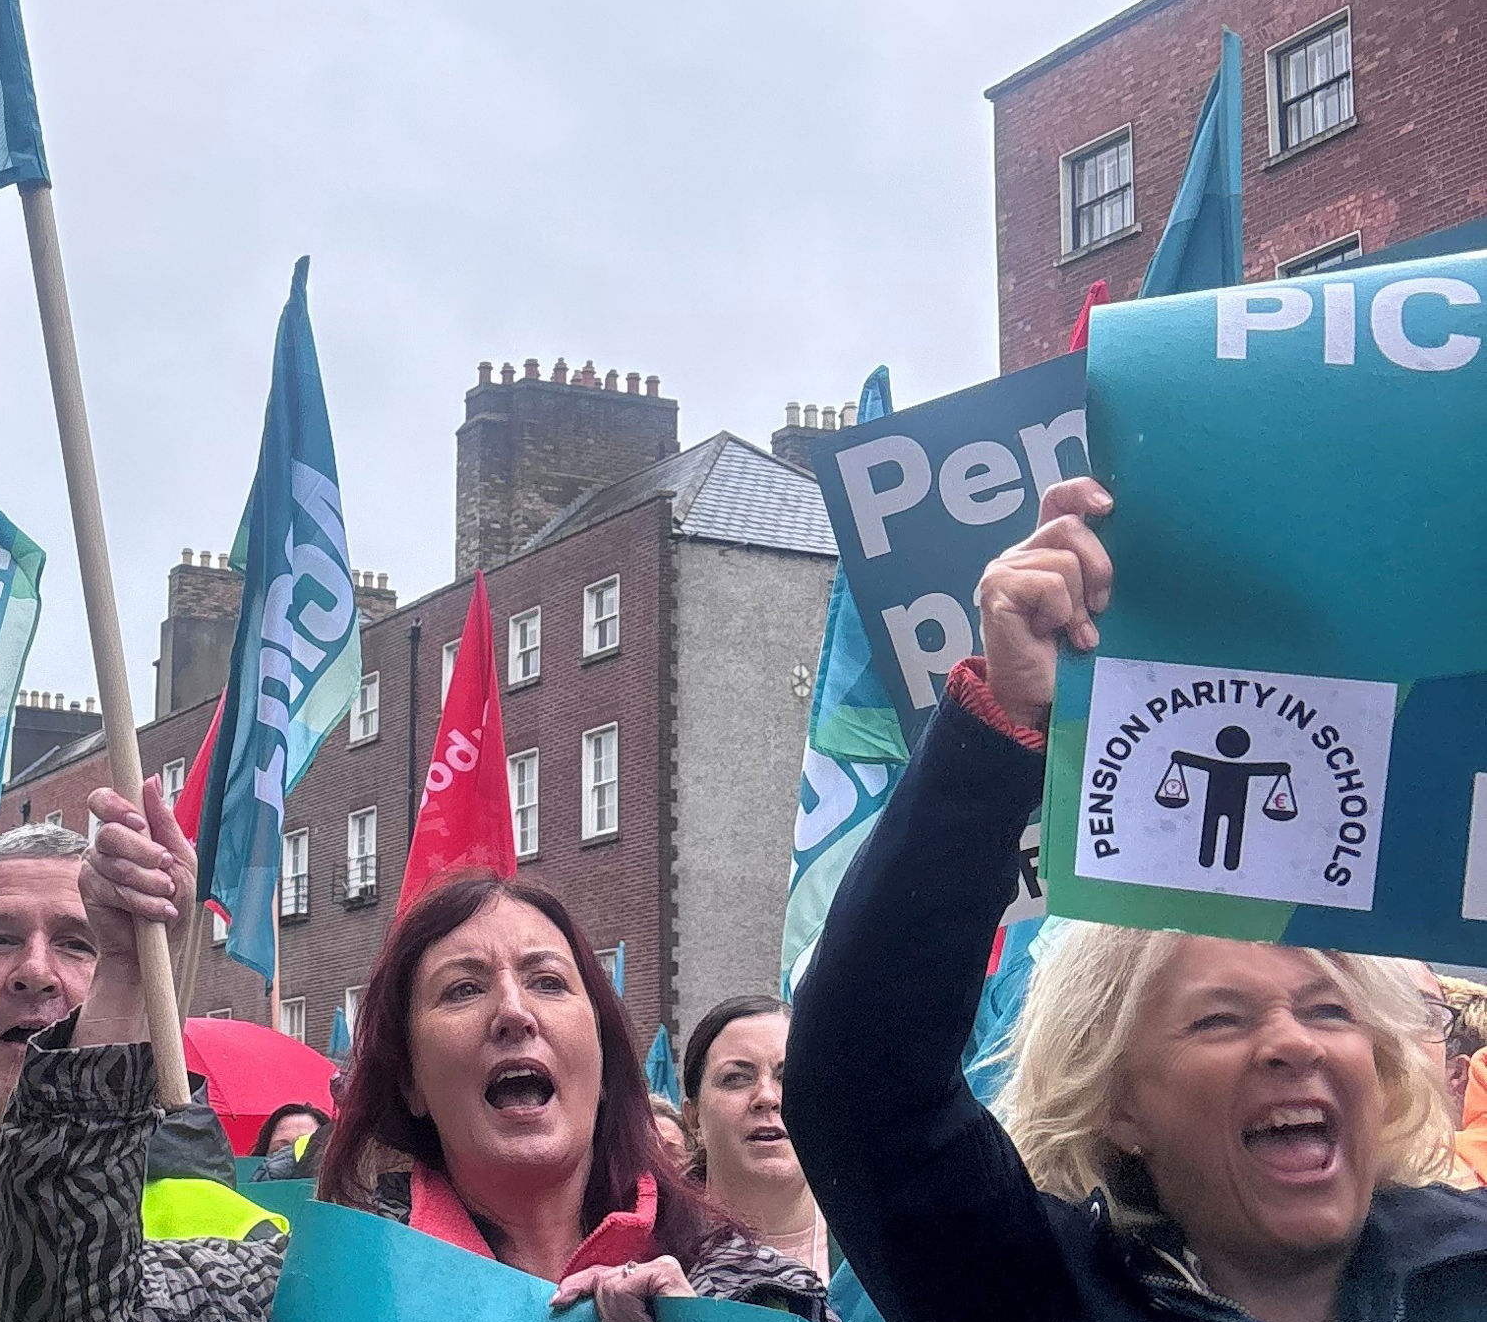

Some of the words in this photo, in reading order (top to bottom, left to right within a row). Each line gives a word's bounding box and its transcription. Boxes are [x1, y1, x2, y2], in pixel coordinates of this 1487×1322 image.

[1089, 714, 1151, 859] PENSION
[1146, 679, 1276, 723] PARITY
[1277, 694, 1317, 731] IN
[1312, 725, 1368, 886] SCHOOLS
